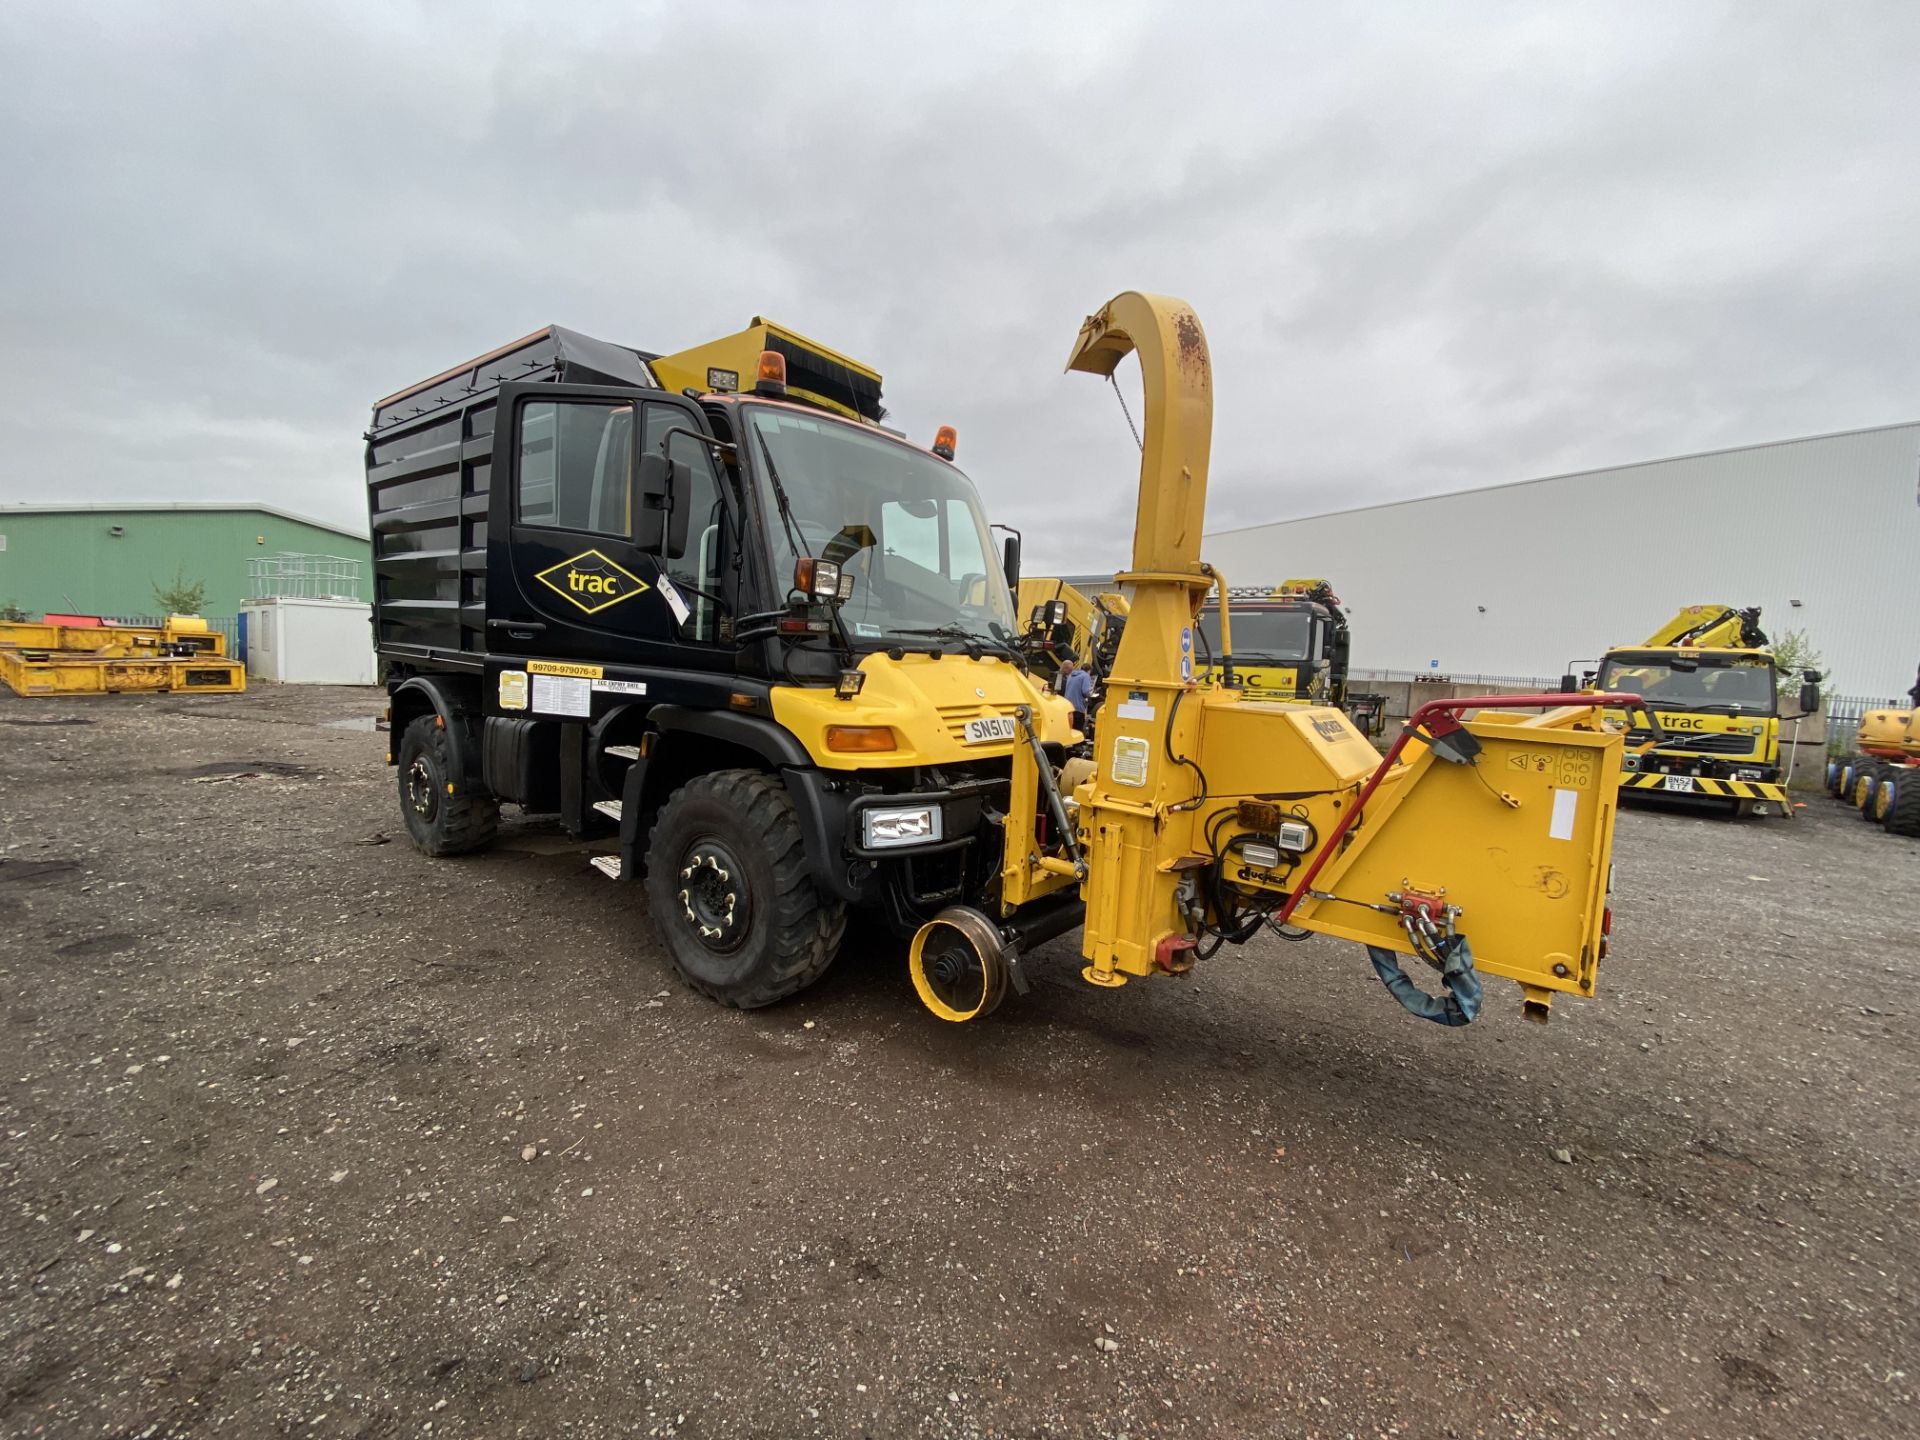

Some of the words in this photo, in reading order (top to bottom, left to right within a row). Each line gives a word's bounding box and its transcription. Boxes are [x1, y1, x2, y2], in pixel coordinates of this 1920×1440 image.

[567, 569, 617, 595] trac
[532, 663, 598, 676] 99709-979076-5
[971, 719, 1003, 739] SN51
[1661, 714, 1703, 730] trac
[1667, 775, 1691, 784] BN52
